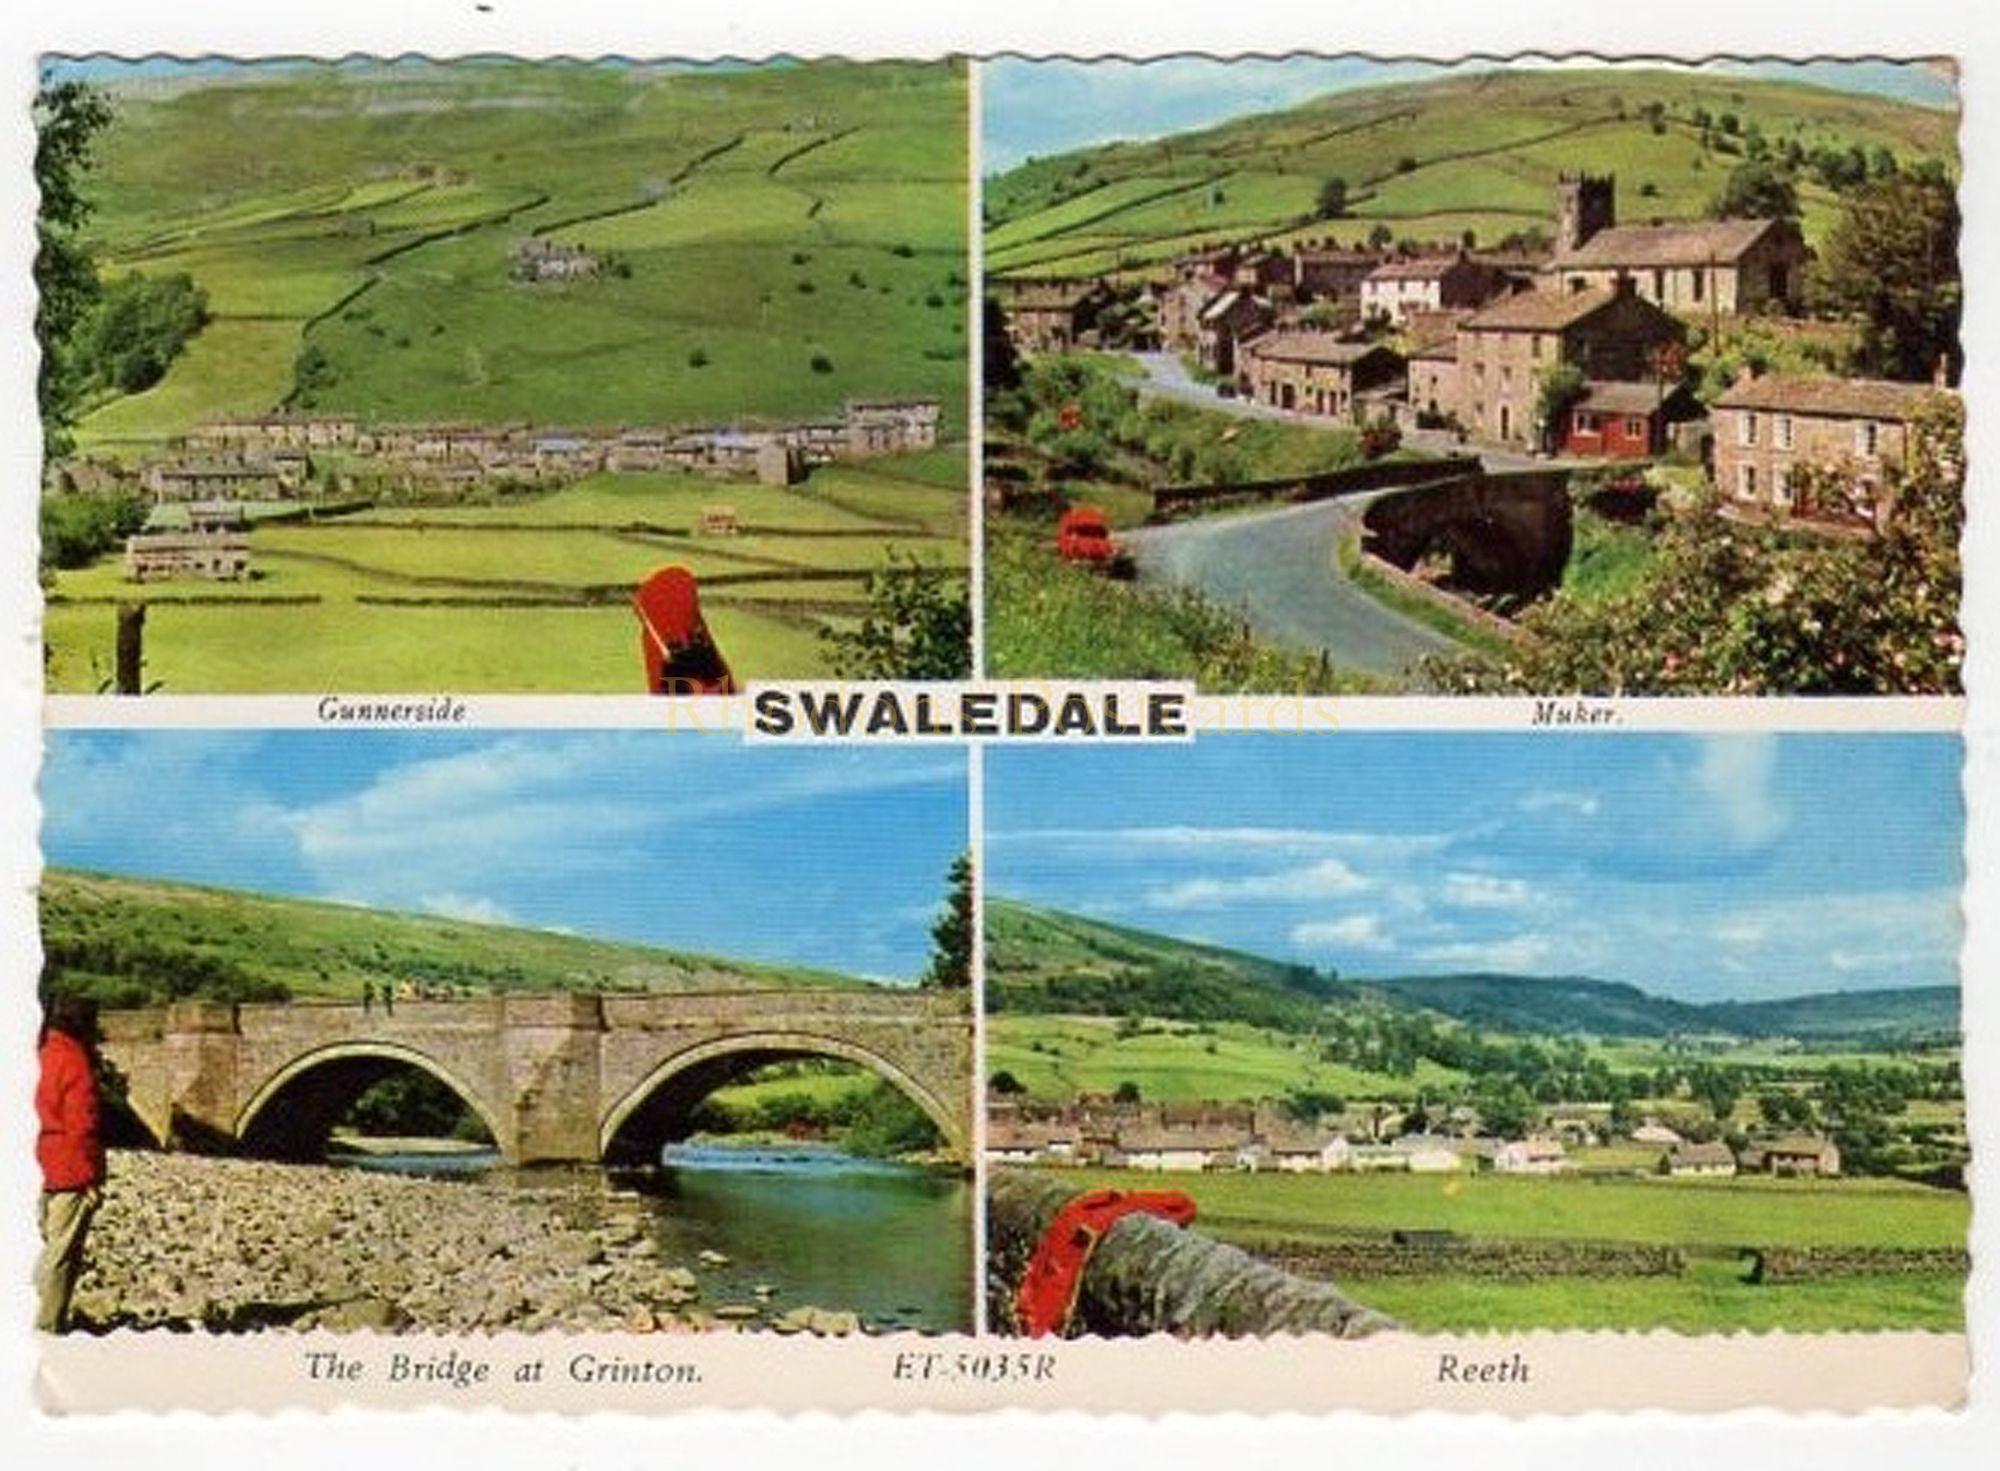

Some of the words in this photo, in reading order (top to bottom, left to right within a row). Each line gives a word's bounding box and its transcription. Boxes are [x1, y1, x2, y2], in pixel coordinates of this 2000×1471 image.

[317, 696, 466, 722] Gunnerside
[755, 690, 1187, 736] SWALEDALE
[1531, 700, 1624, 725] Muker.
[304, 1352, 363, 1382] The
[388, 1350, 490, 1388] Bridge
[514, 1355, 543, 1383] at
[568, 1353, 703, 1384] Grinton.
[1438, 1352, 1529, 1383] Reeth
